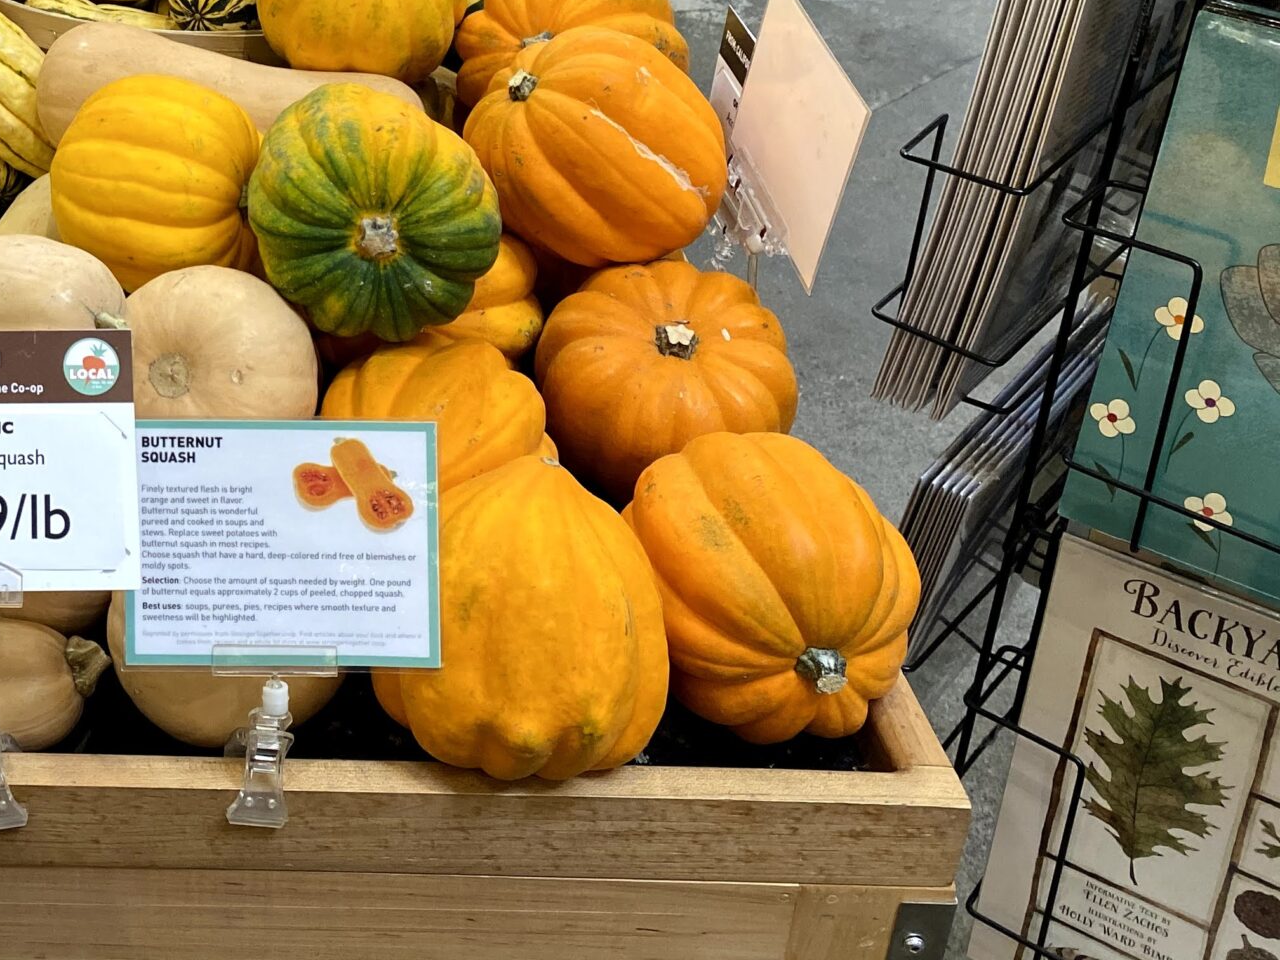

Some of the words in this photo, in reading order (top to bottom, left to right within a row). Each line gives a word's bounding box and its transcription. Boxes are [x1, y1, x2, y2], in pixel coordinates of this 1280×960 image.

[69, 368, 114, 380] LOCAL
[10, 383, 44, 397] Co-op
[141, 436, 223, 448] BUTTERNUT
[141, 451, 196, 463] SQUASH
[141, 485, 164, 494] Finely
[166, 485, 199, 493] textured
[201, 485, 219, 493] flesh
[229, 485, 252, 495] bright
[142, 507, 179, 515] Butternut
[180, 507, 208, 516] squash
[210, 507, 217, 515] is
[218, 507, 258, 515] wonderful
[225, 519, 248, 529] soups
[168, 528, 199, 537] Replace
[226, 529, 259, 538] potatoes
[260, 529, 277, 537] with
[183, 576, 212, 584] Choose
[214, 576, 226, 584] the
[228, 577, 258, 585] amount
[260, 577, 267, 585] of
[269, 577, 297, 587] squash
[299, 578, 327, 586] needed
[329, 578, 338, 587] by
[369, 578, 385, 586] One
[387, 579, 411, 588] pound
[142, 602, 160, 610] Best
[264, 603, 292, 612] recipes
[320, 604, 350, 612] smooth
[351, 604, 380, 612] texture
[1149, 627, 1220, 669] Discover
[1086, 880, 1136, 910] INFORMATIVE
[1139, 904, 1159, 921] TEXT
[1161, 916, 1171, 926] BY
[1083, 888, 1120, 914] ELLEN
[1123, 910, 1170, 938] ZACHOS
[1059, 904, 1095, 928] HOLLY
[1099, 923, 1136, 949] WARD
[1088, 907, 1144, 940] ILLUSTRATIONS
[1147, 935, 1157, 945] BY
